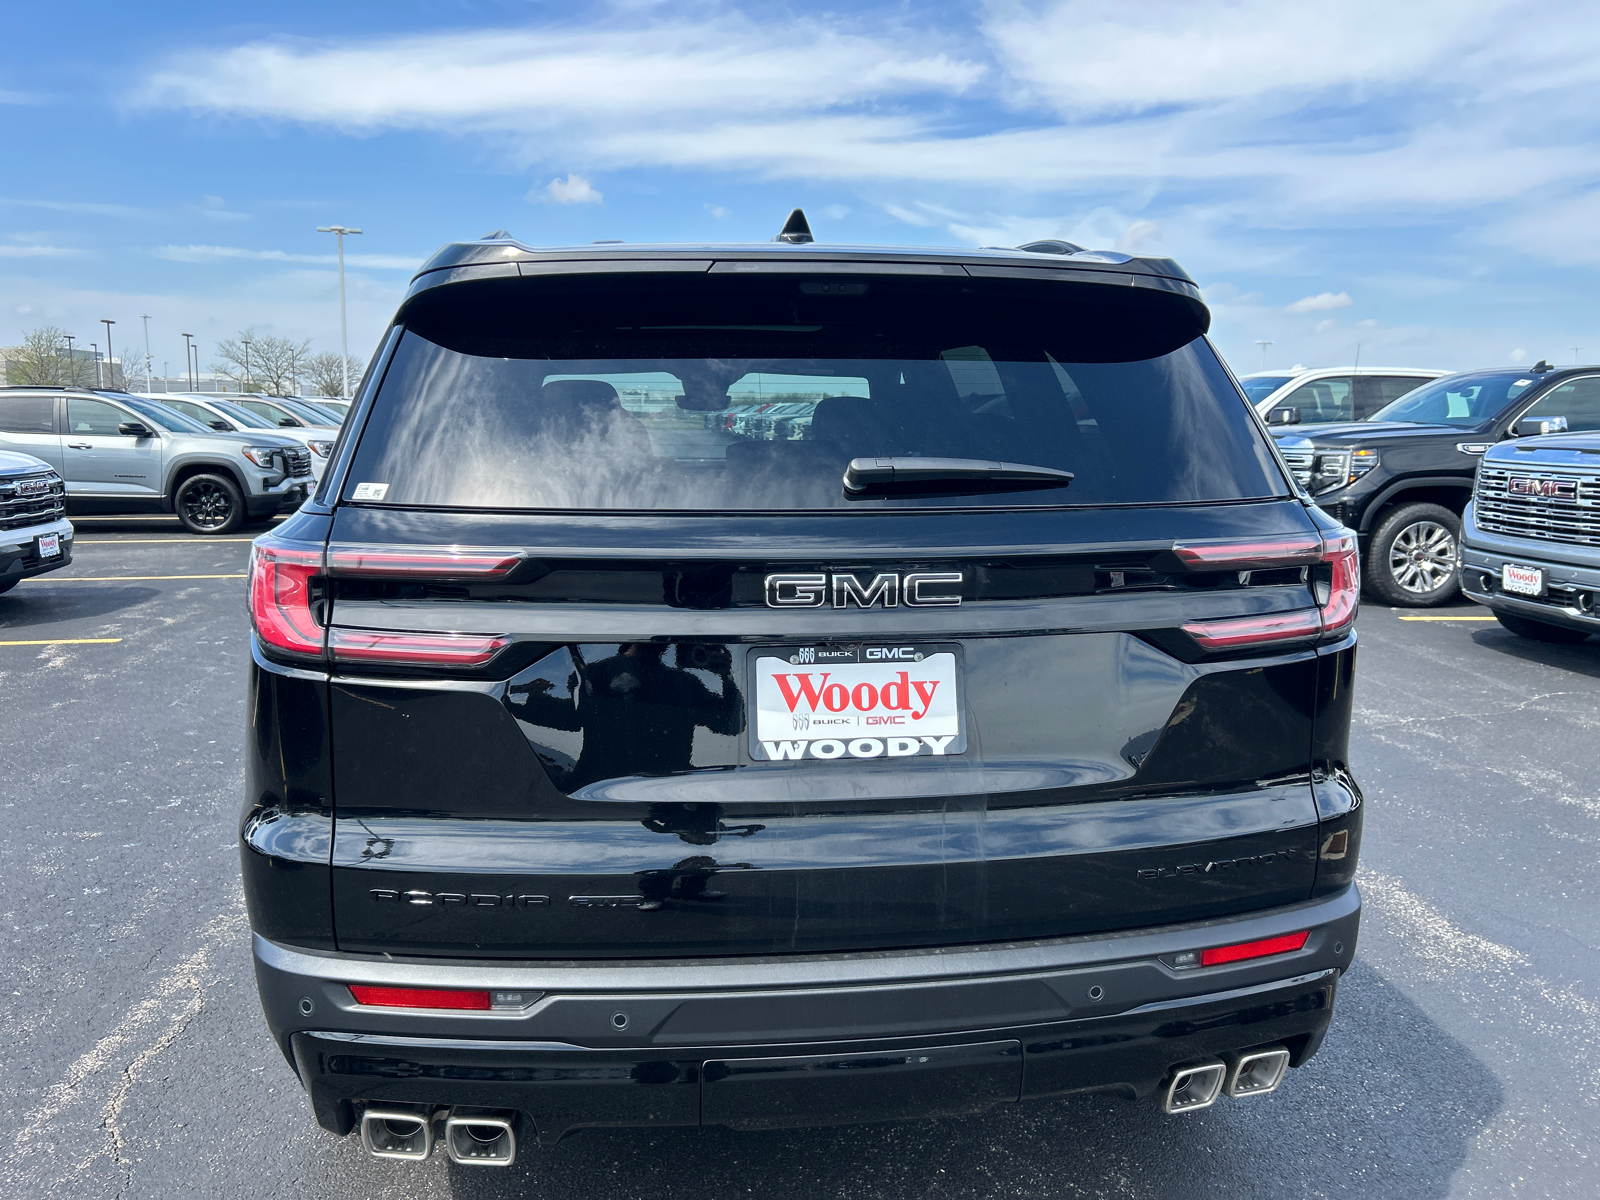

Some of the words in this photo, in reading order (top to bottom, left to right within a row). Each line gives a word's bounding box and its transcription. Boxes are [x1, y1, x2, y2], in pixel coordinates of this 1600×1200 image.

[1510, 478, 1576, 499] GMC
[1507, 568, 1540, 586] Woody
[764, 572, 963, 609] GMC
[818, 650, 854, 658] BUICK
[866, 647, 915, 659] GMC
[771, 671, 940, 720] Woody
[865, 715, 906, 725] GMC
[762, 735, 956, 761] WOODY
[368, 888, 551, 911] ACADIA
